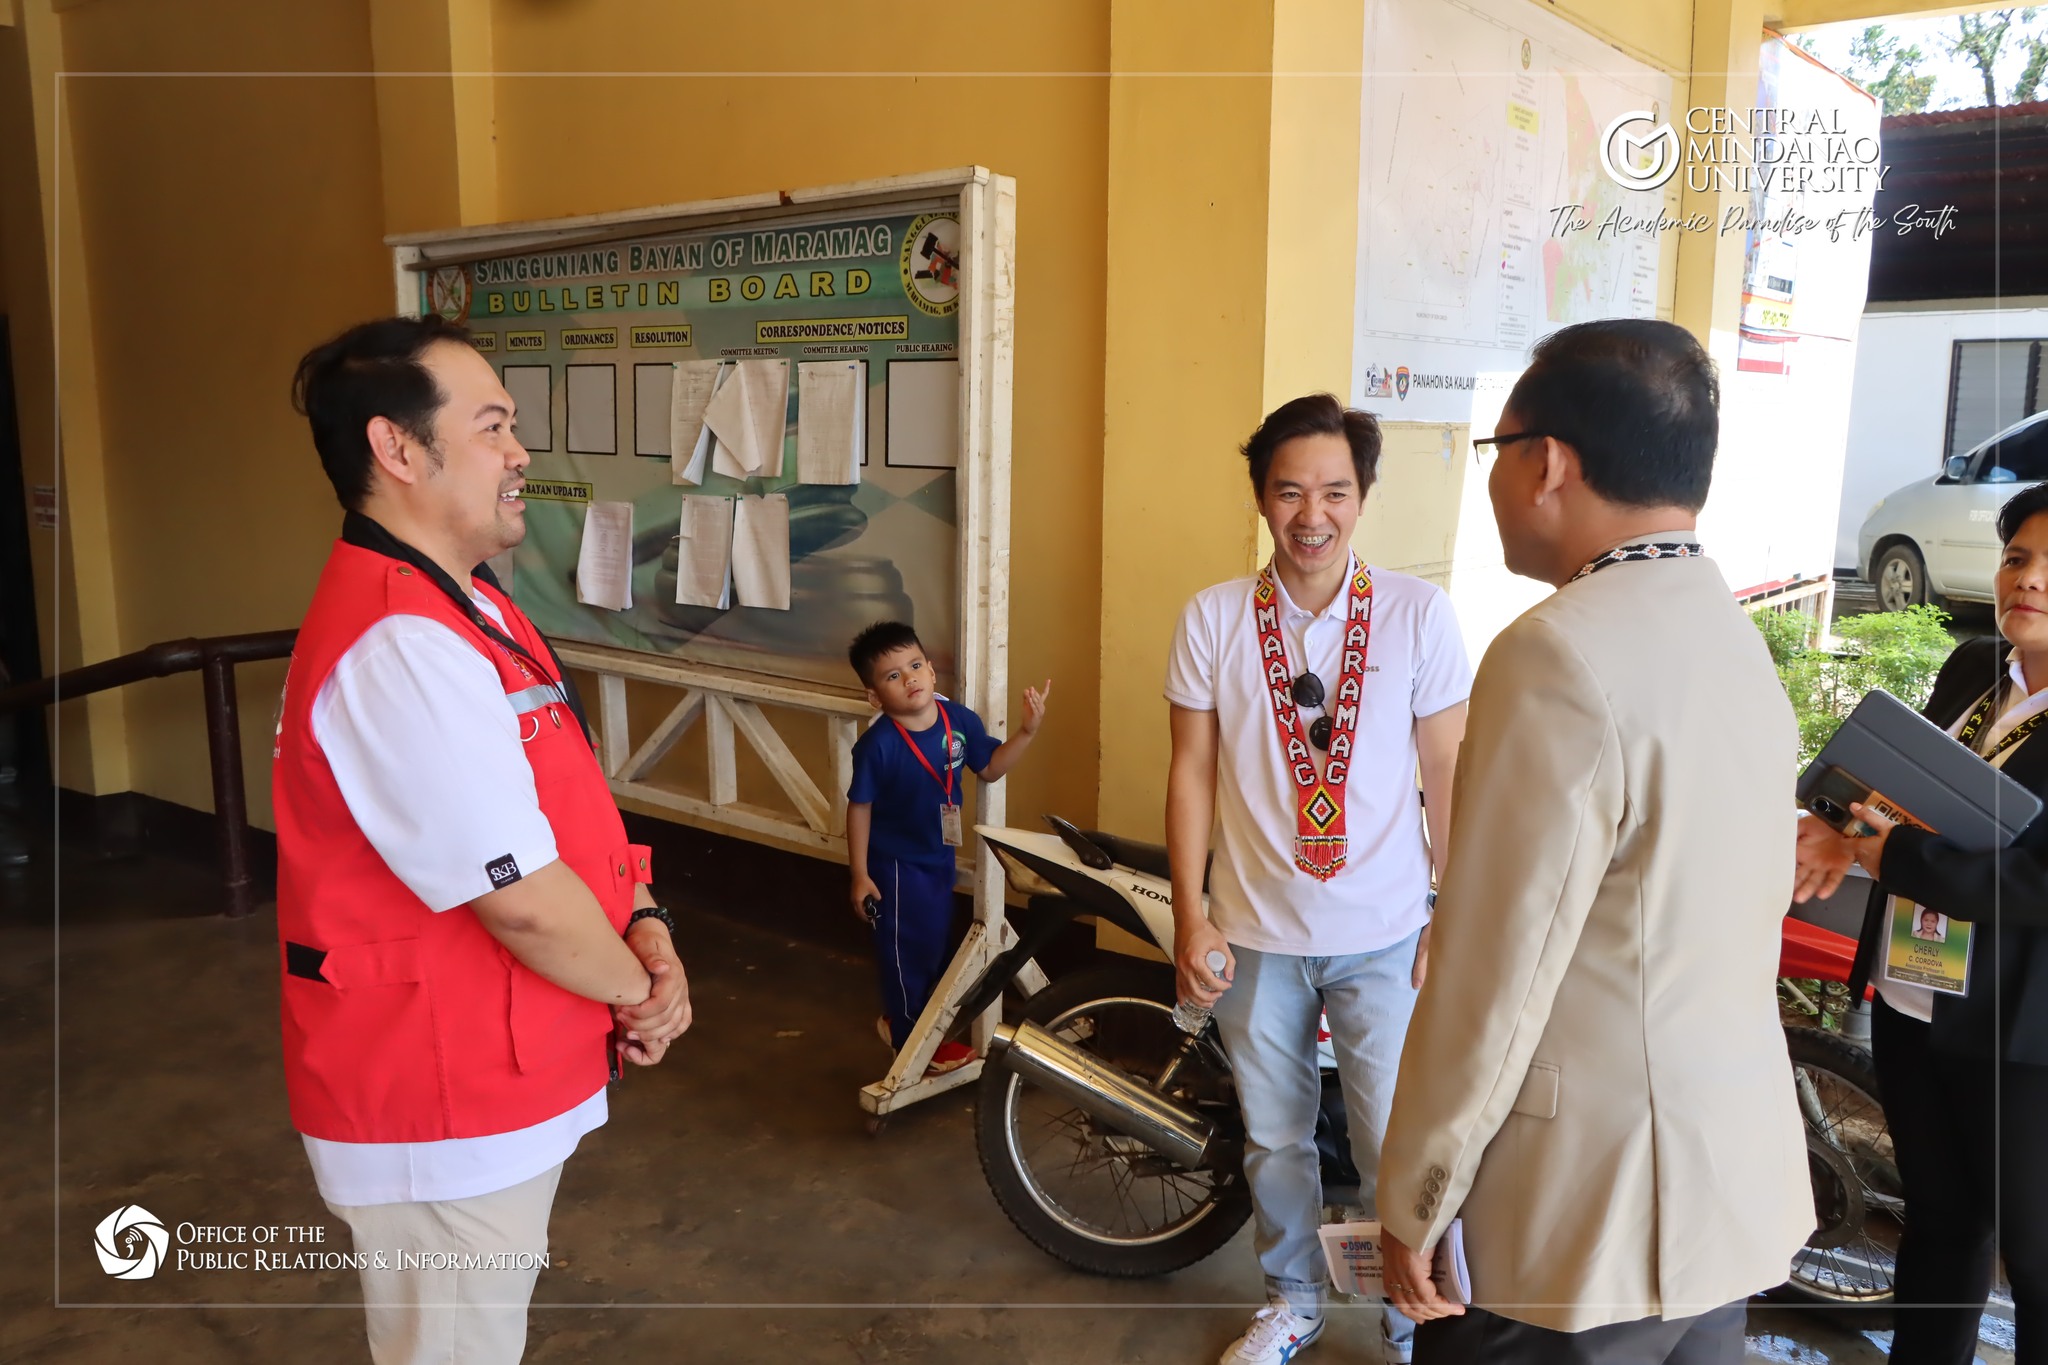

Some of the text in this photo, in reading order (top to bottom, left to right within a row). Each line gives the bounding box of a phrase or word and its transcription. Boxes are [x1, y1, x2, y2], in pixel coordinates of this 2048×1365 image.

[474, 224, 892, 285] SANGGUNIANG BAYAN OF MARAMAG
[489, 268, 872, 314] BULLETIN BOARD
[635, 329, 689, 345] RESOLUTION
[760, 321, 905, 339] CORRESPONDENCE/NOTICES
[509, 336, 543, 348] MINUTES
[564, 332, 615, 345] ORDINANCES
[720, 347, 779, 356] COMMITTEE MEETING
[803, 344, 869, 354] COMMITTEE HEARING
[896, 343, 953, 353] PUBLIC HEARING
[1413, 374, 1444, 389] PANAHON
[1444, 375, 1455, 390] SA
[1454, 376, 1476, 391] KALAM
[526, 484, 552, 495] BAYAN
[552, 485, 587, 498] UPDATES
[1130, 884, 1173, 905] HON
[1913, 943, 1940, 957] CHERLY
[1914, 956, 1943, 968] CORDOVA
[1349, 1240, 1373, 1252] DSWD
